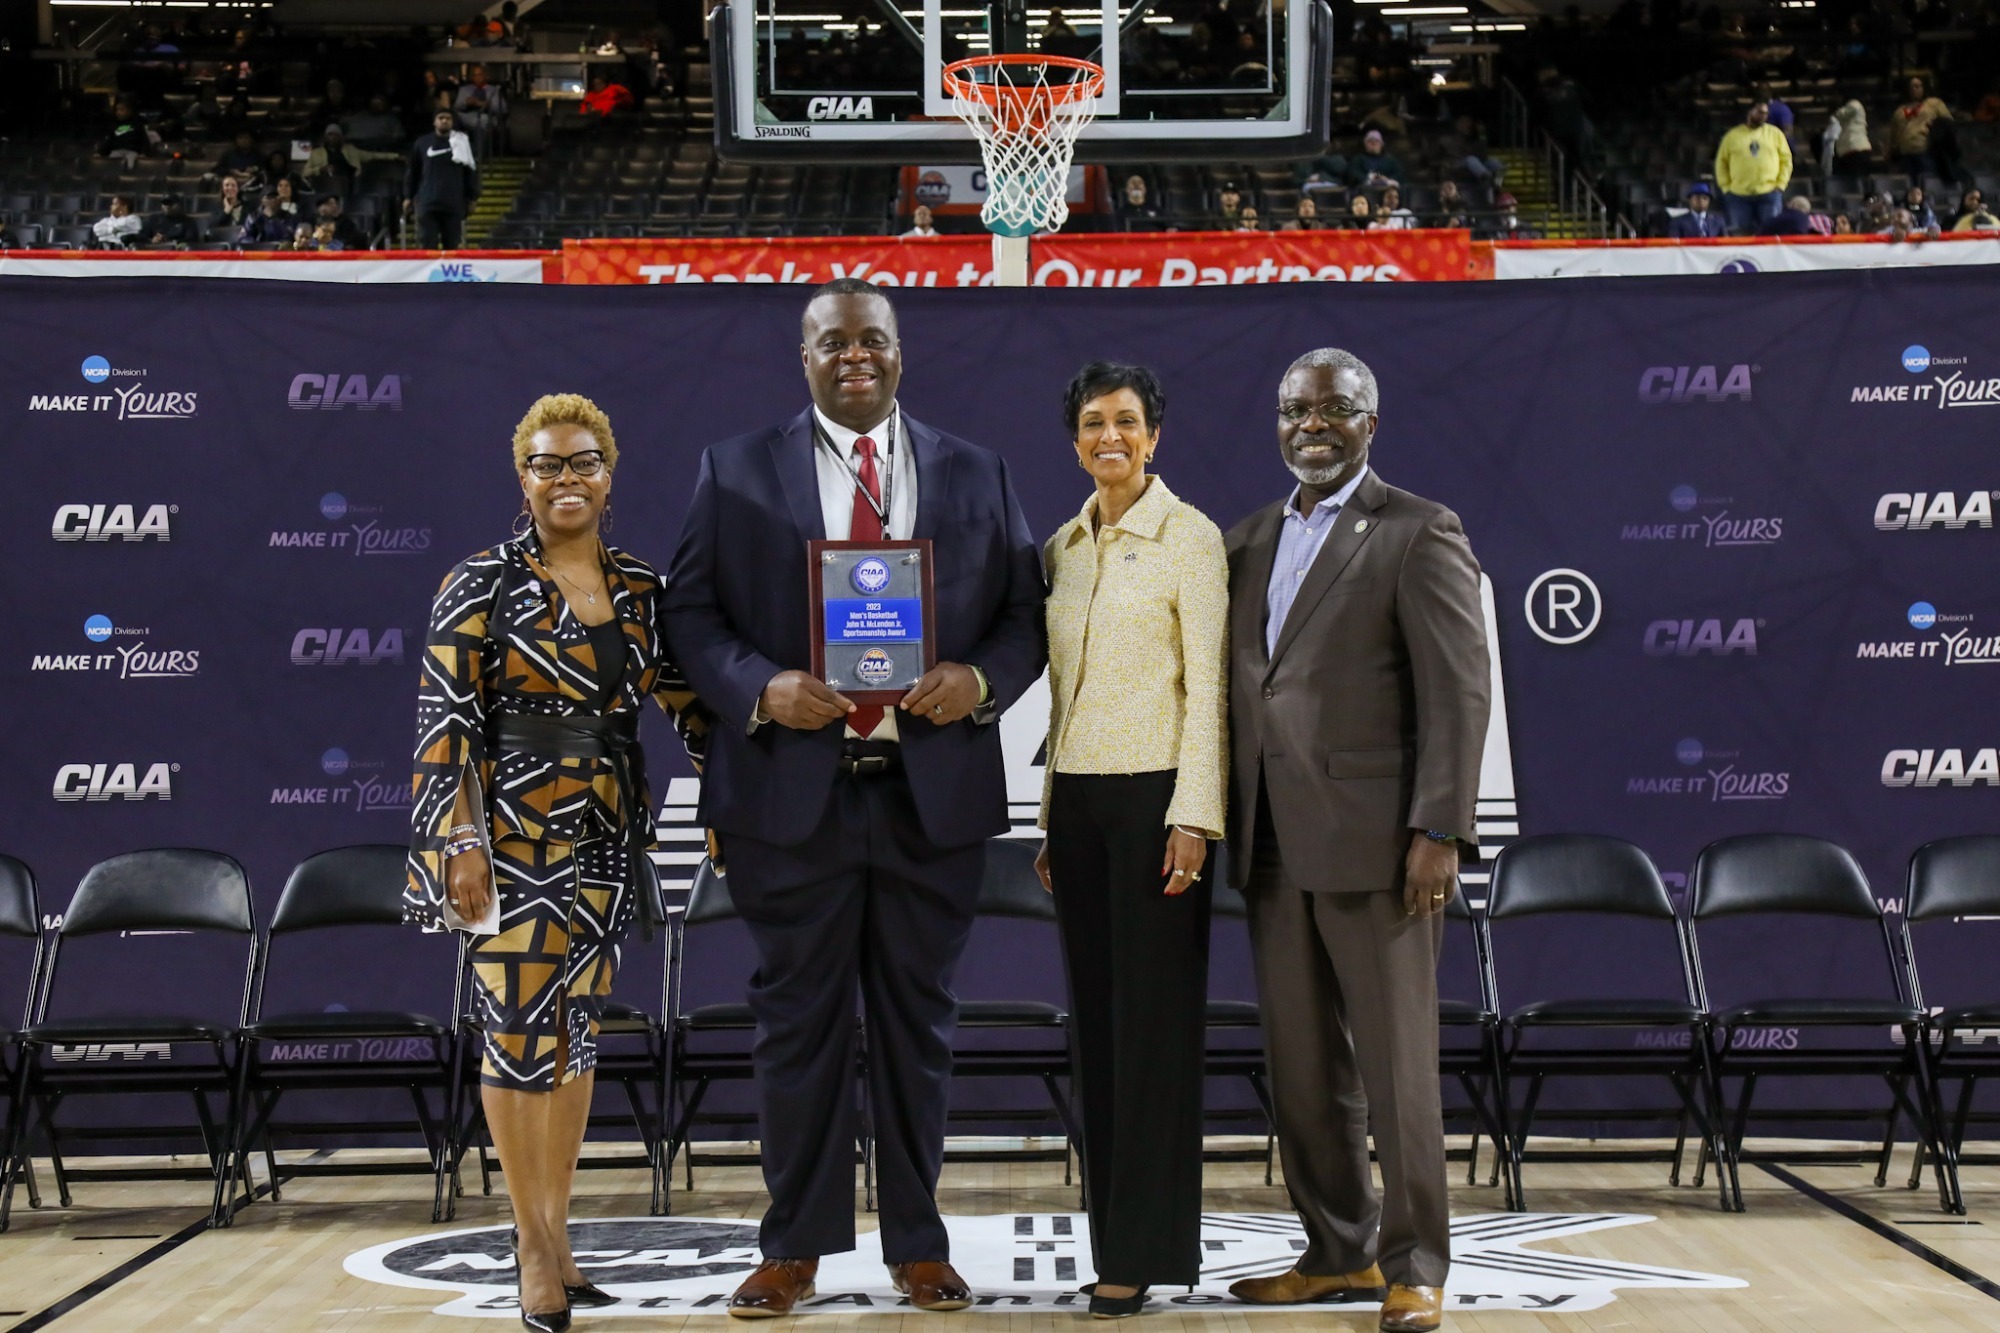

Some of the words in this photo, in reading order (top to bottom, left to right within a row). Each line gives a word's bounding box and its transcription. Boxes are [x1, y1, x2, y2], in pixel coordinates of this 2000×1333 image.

[807, 97, 873, 119] CIAA
[755, 126, 811, 138] SPALDING
[441, 264, 473, 277] WE
[956, 262, 994, 287] t
[1034, 259, 1142, 287] Our
[84, 368, 110, 376] NCAA
[112, 368, 141, 376] Division
[1905, 358, 1930, 366] NCAA
[1932, 357, 1961, 365] Division
[288, 373, 402, 411] CIAA
[1851, 386, 1909, 402] MAKE
[1914, 385, 1933, 400] IT
[1934, 370, 2000, 409] YOUR
[29, 395, 88, 411] MAKE
[93, 396, 113, 410] IT
[114, 382, 197, 420] YOURS
[269, 532, 326, 547] MAKE
[331, 532, 350, 547] IT
[351, 519, 431, 556] YOURS
[1621, 525, 1677, 540] MAKE
[1681, 524, 1700, 539] IT
[1702, 510, 1783, 548] YOURS
[866, 603, 881, 611] 2023
[1911, 614, 1936, 623] NCAA
[1938, 614, 1967, 622] Division
[87, 628, 112, 636] NCAA
[115, 627, 144, 635] Division
[290, 628, 404, 665] CIAA
[1857, 642, 1915, 658] MAKE
[1920, 642, 1939, 657] IT
[31, 655, 91, 670] MAKE
[95, 655, 115, 670] IT
[116, 641, 199, 679] YOURS
[861, 661, 890, 672] CIAA
[270, 788, 328, 804] MAKE
[332, 788, 351, 803] IT
[353, 774, 413, 812] YOUR
[1626, 778, 1682, 793] MAKE
[1687, 778, 1706, 792] IT
[1708, 764, 1789, 802] YOURS
[270, 1045, 329, 1060] MAKE
[333, 1044, 353, 1060] IT
